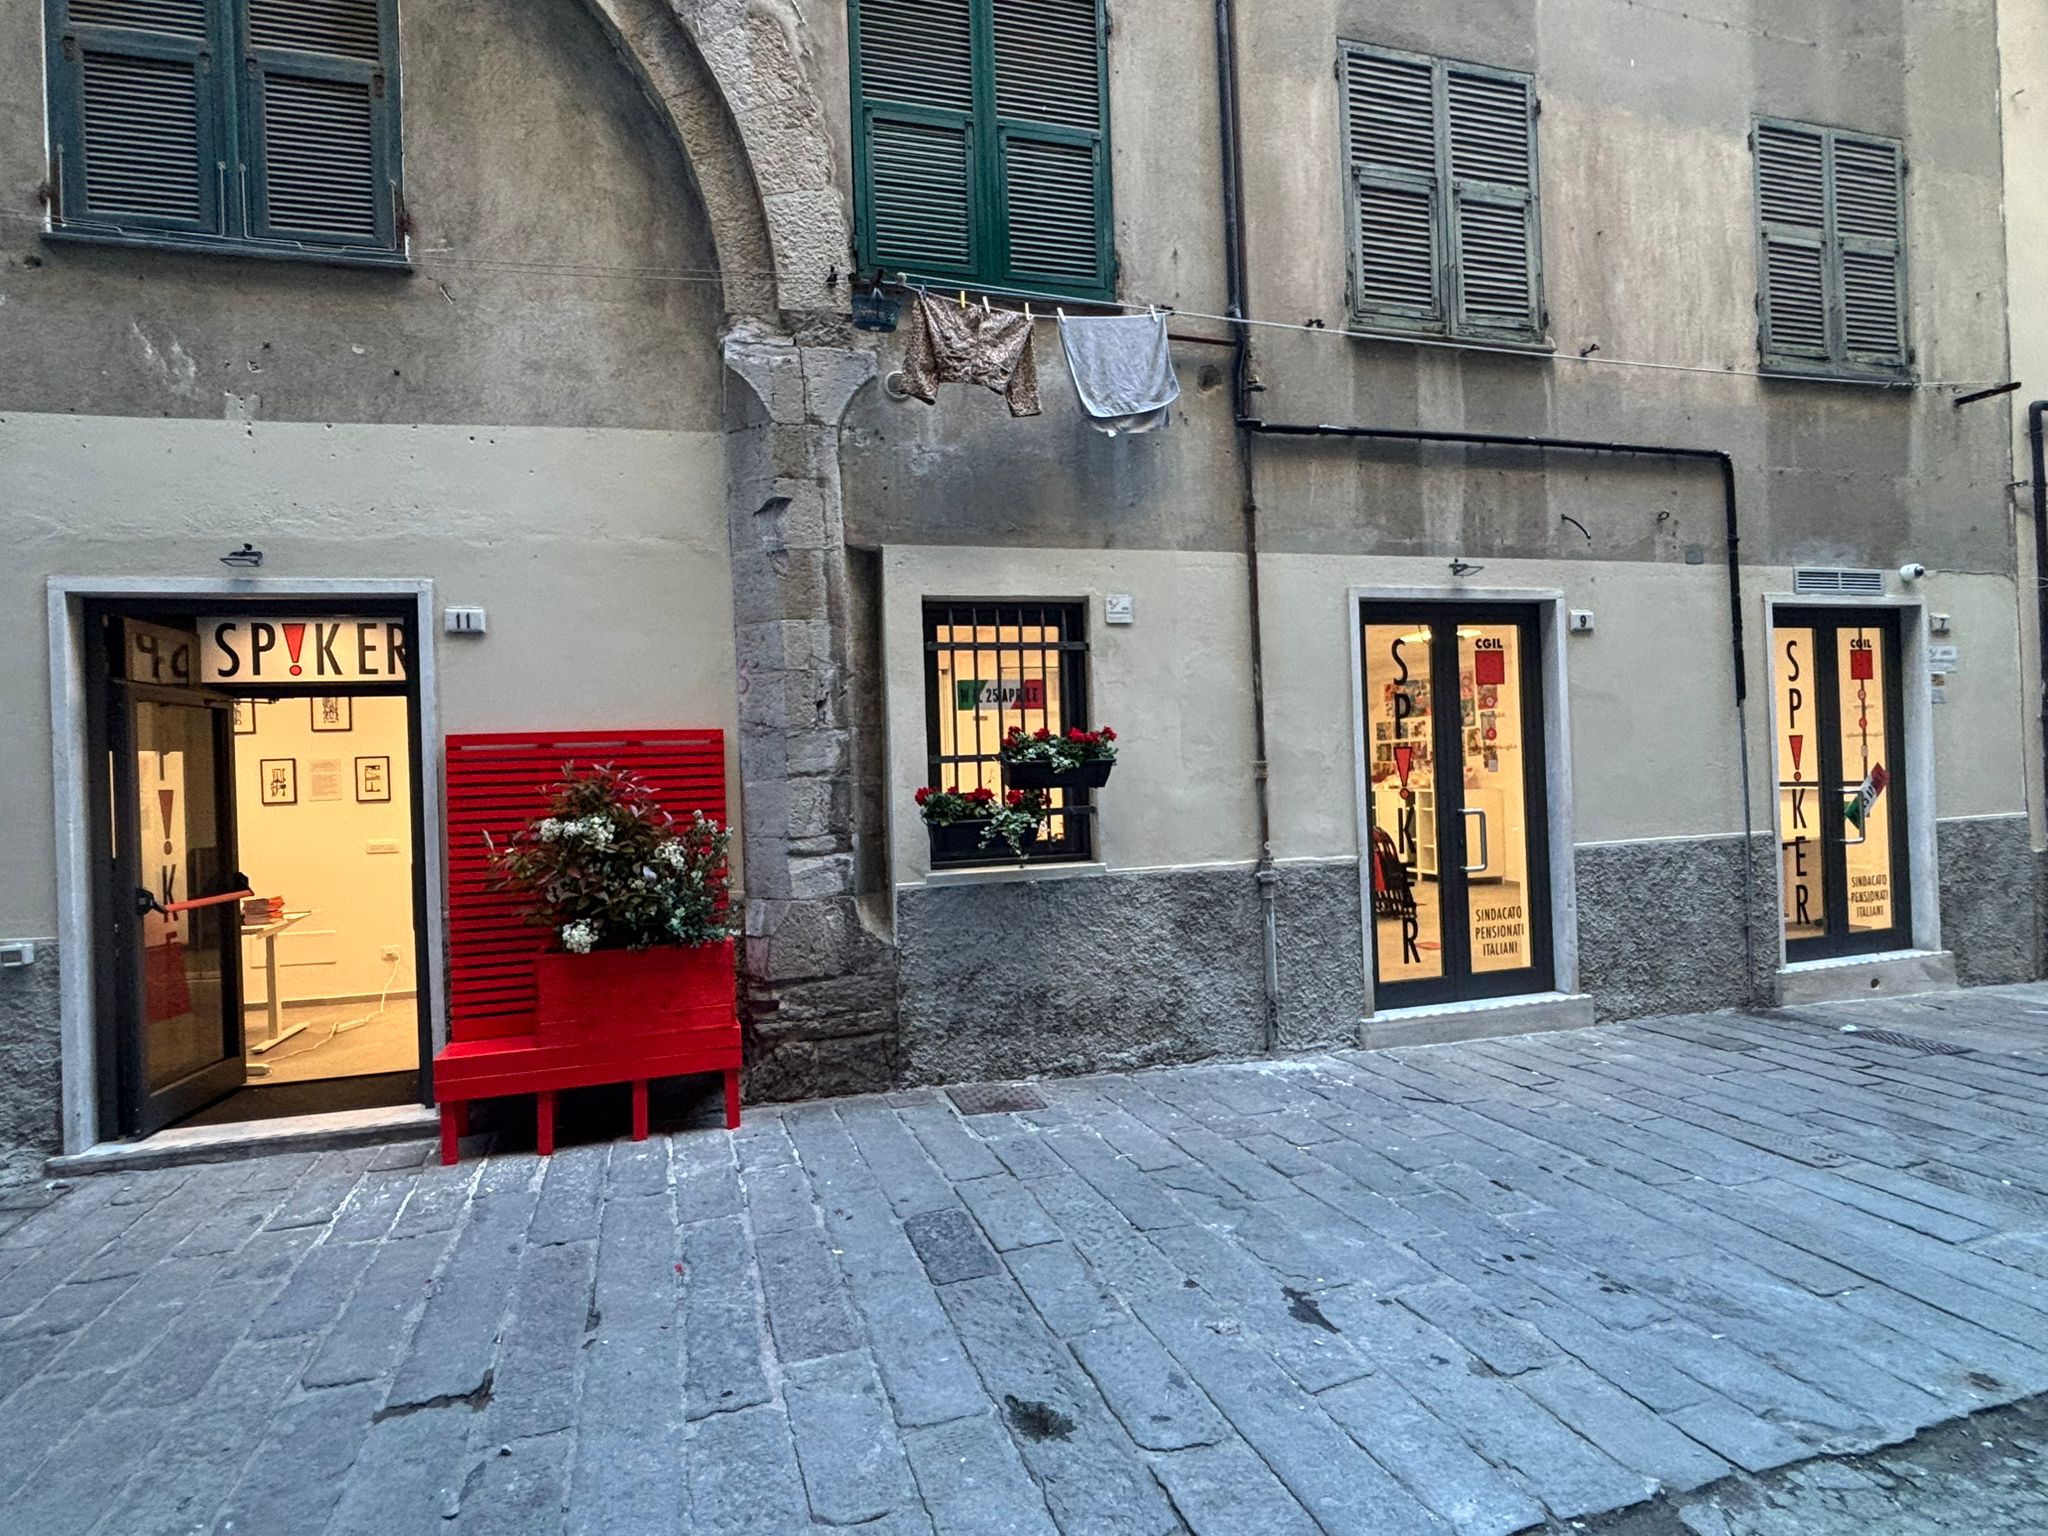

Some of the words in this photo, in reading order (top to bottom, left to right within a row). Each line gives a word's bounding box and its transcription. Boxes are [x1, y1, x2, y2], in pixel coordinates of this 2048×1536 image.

[456, 612, 470, 629] 11
[1580, 615, 1587, 628] 9
[1940, 618, 1946, 629] 7
[1475, 638, 1503, 649] CGIL
[986, 688, 999, 703] 25
[1001, 687, 1038, 703] APRLE
[1851, 874, 1887, 888] SINDACATO
[1851, 890, 1889, 904] PENSIONATI
[1475, 905, 1522, 923] SINDACATO
[1856, 905, 1884, 918] ITALIANI
[1475, 923, 1524, 940] PENSIONATI
[1483, 941, 1518, 956] ITALIANI
